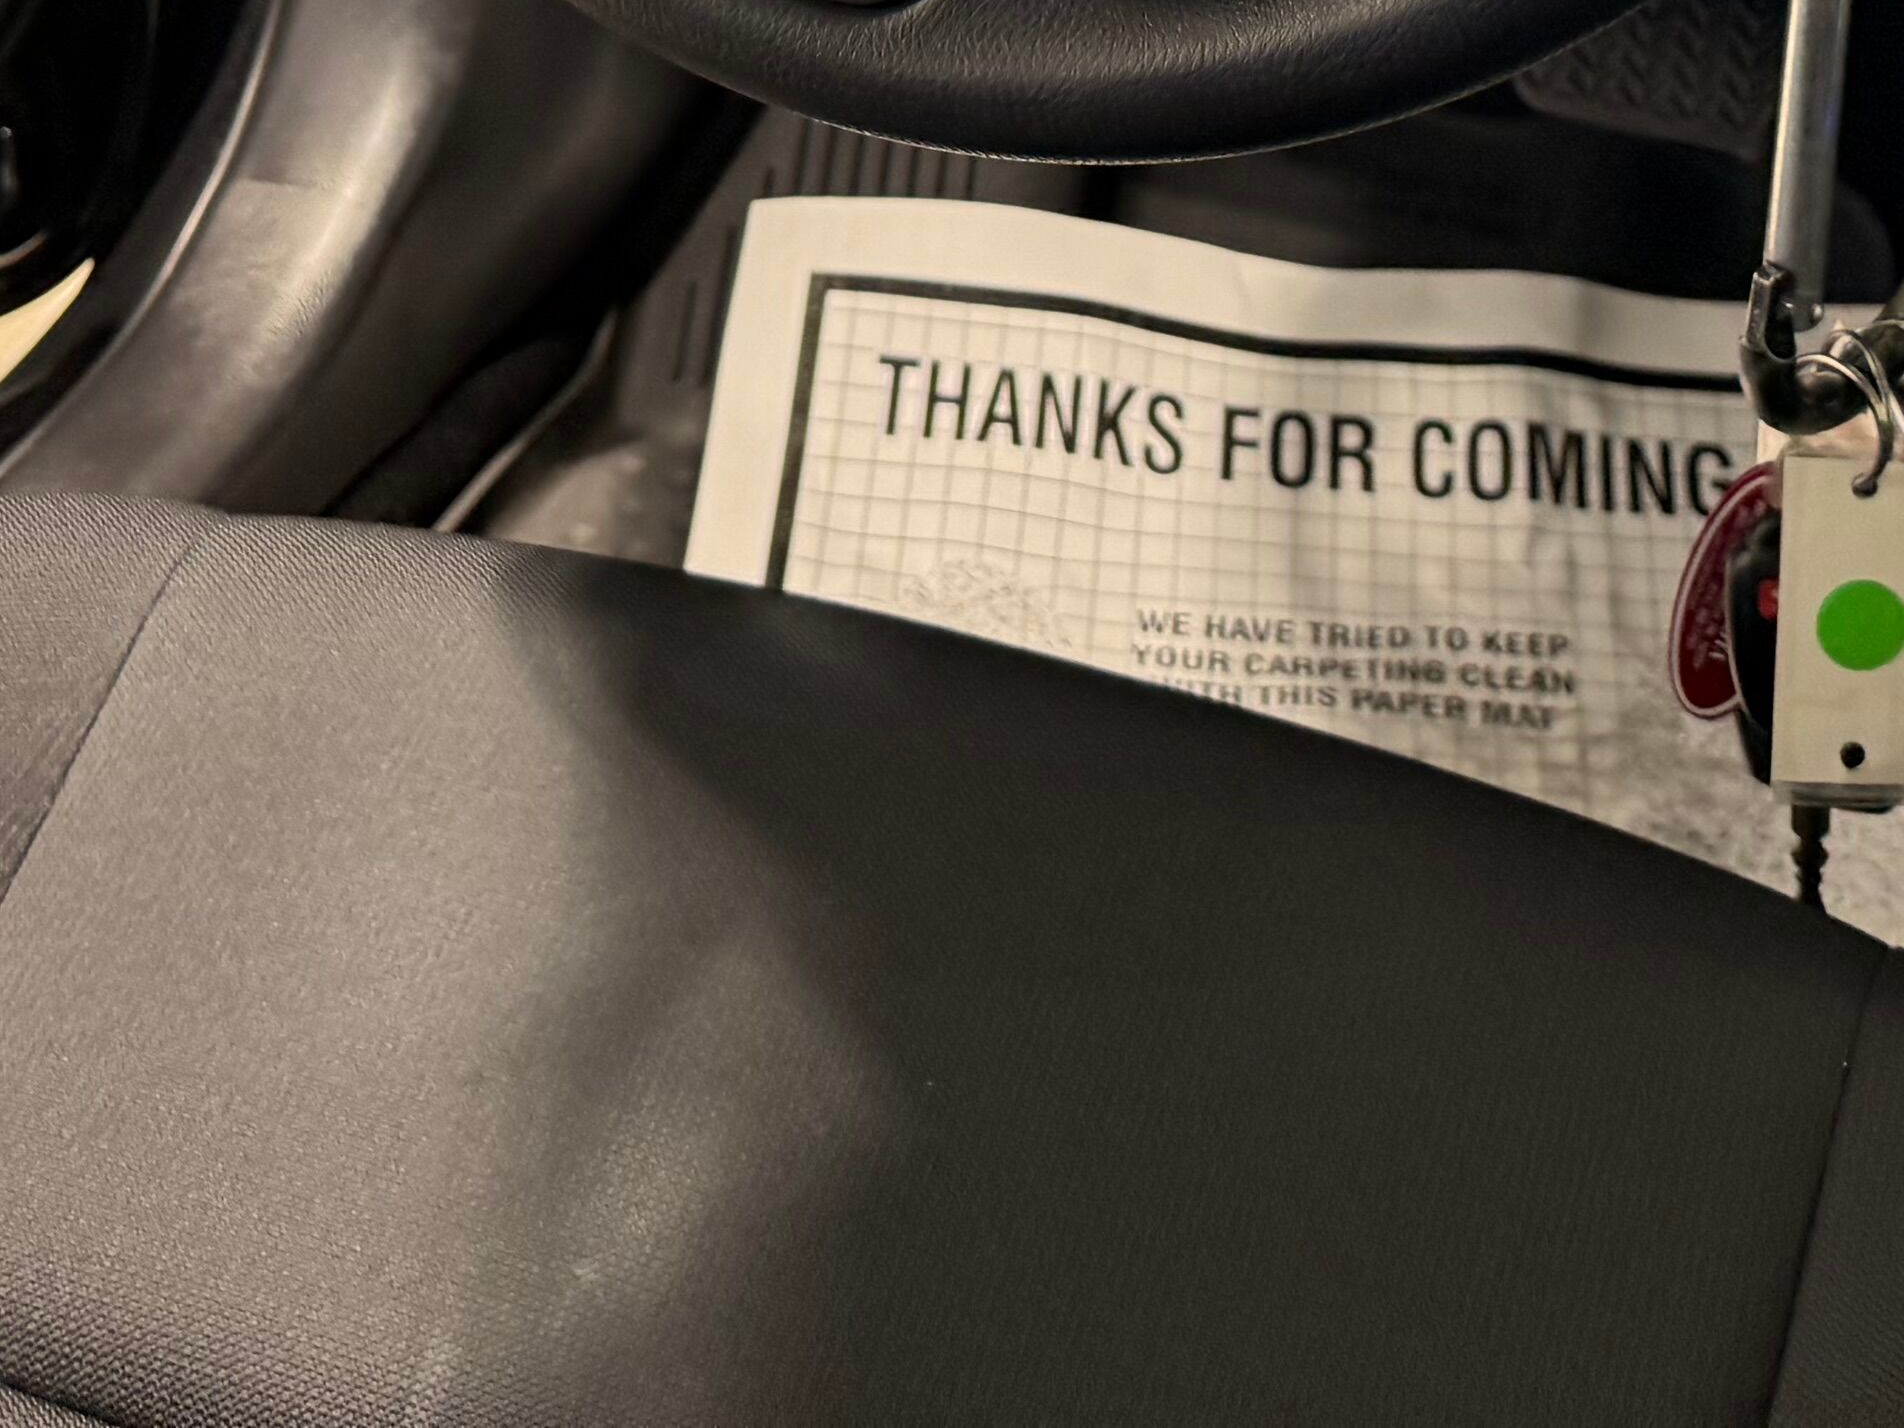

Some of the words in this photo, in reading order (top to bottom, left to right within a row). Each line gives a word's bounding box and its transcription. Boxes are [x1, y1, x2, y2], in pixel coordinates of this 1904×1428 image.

[879, 353, 1184, 475] THANKS
[1220, 403, 1375, 493] FOR
[1412, 416, 1733, 517] COMING
[1137, 607, 1191, 636] WE
[1204, 613, 1295, 645] HAVE
[1308, 619, 1411, 651] TRIED
[1421, 624, 1470, 654] TO
[1481, 629, 1570, 658] KEEP
[1132, 643, 1232, 674] YOUR
[1243, 651, 1447, 686] CARPETING
[1457, 662, 1576, 695] CLEAN
[1258, 682, 1337, 710] THIS
[1350, 687, 1469, 721] PAPER
[1480, 699, 1554, 731] MAT
